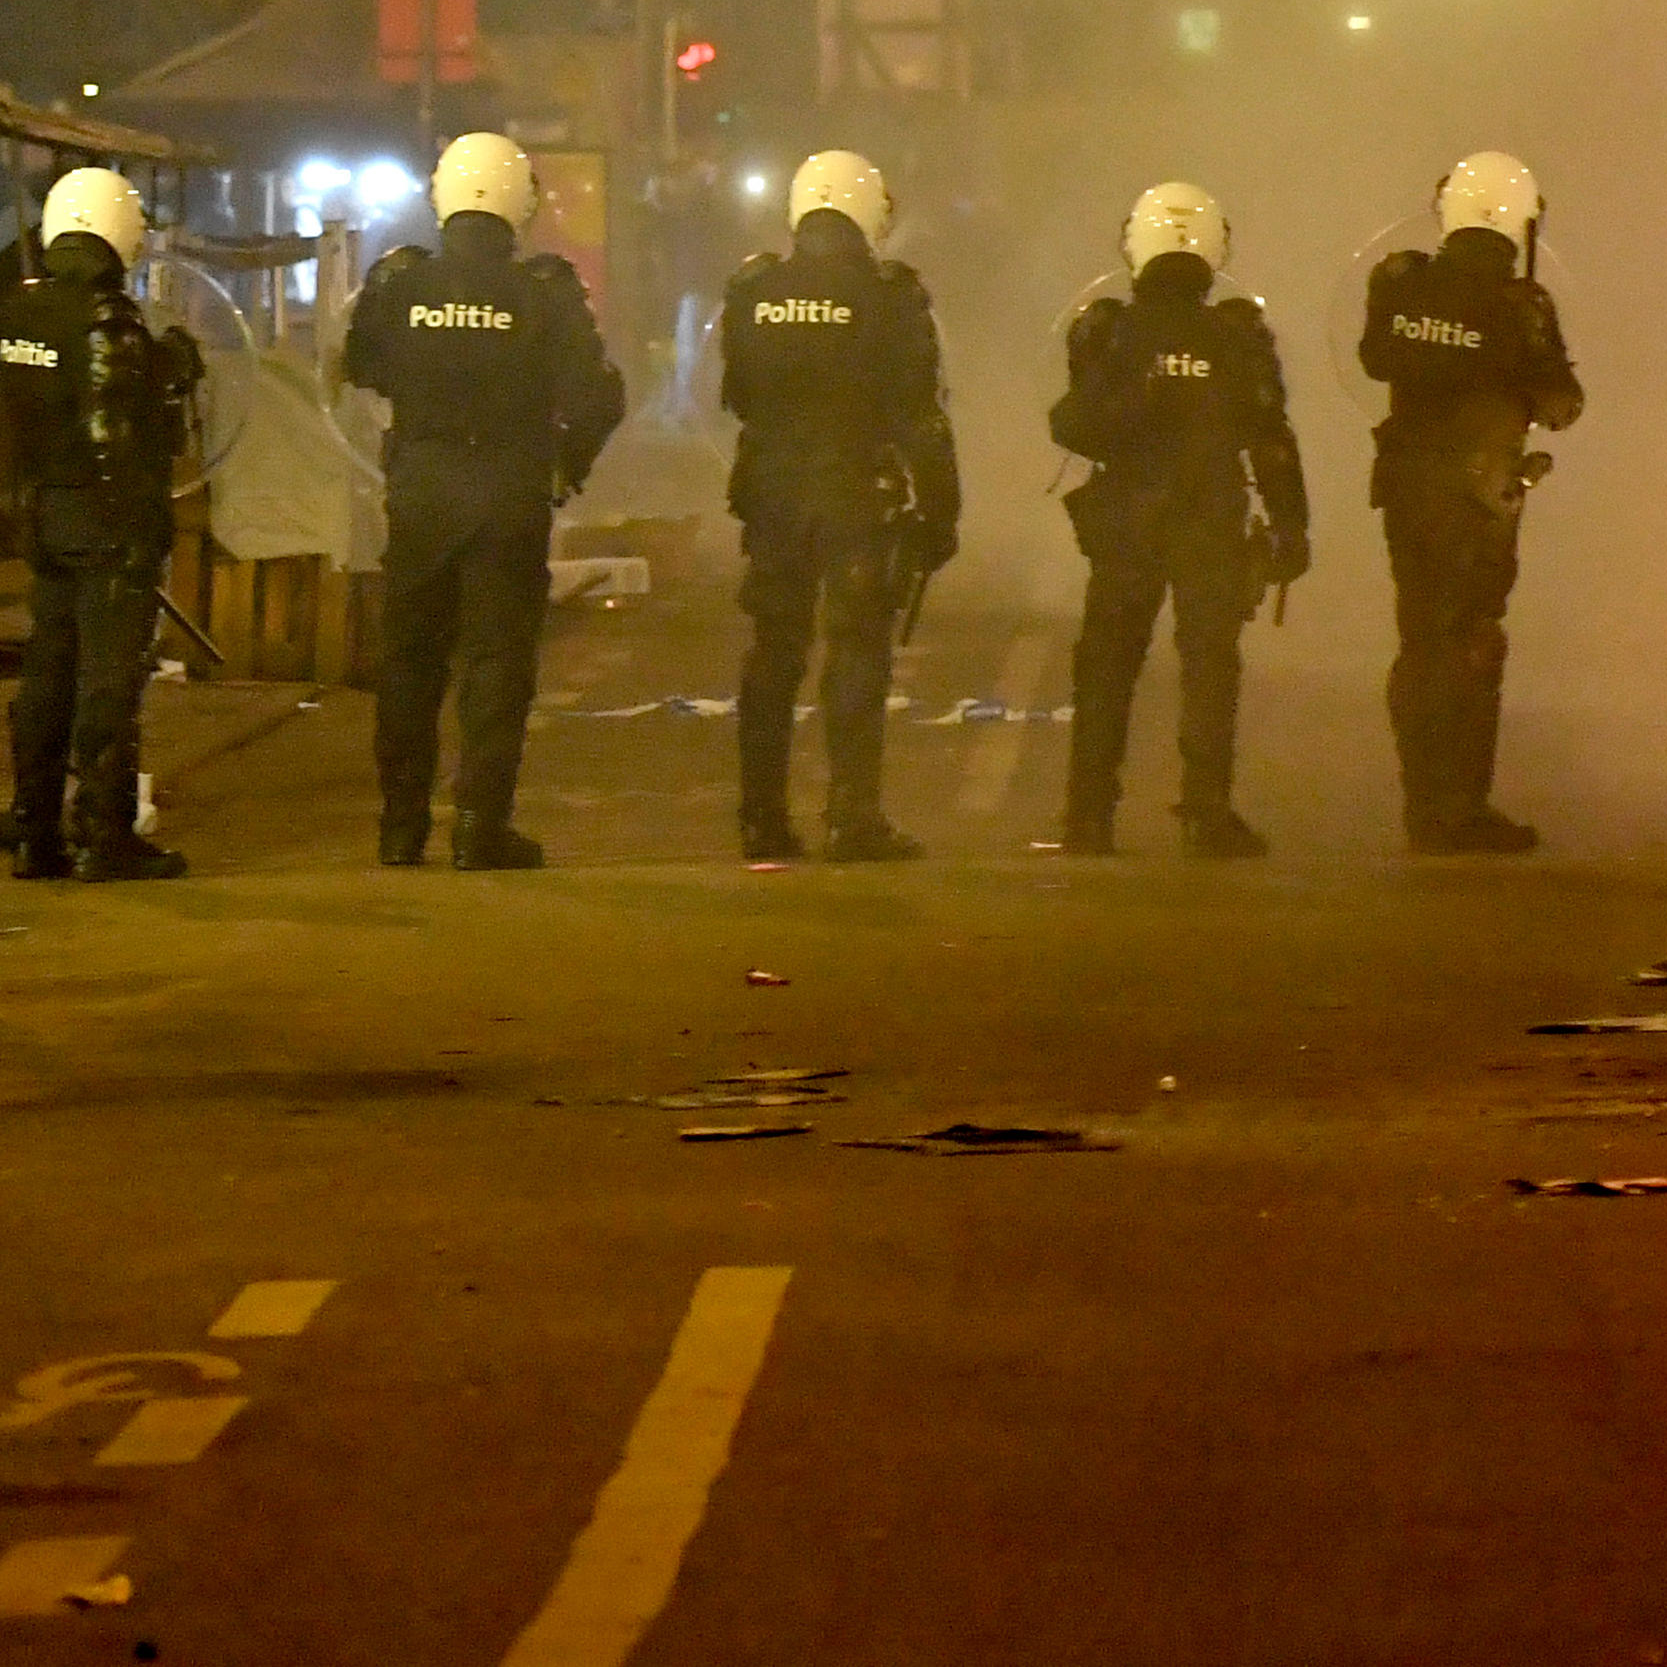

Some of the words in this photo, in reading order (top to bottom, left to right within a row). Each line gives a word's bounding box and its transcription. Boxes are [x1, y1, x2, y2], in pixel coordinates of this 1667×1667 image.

[409, 302, 513, 330] Politie
[754, 298, 853, 324] Politie
[1392, 314, 1481, 348] Politie
